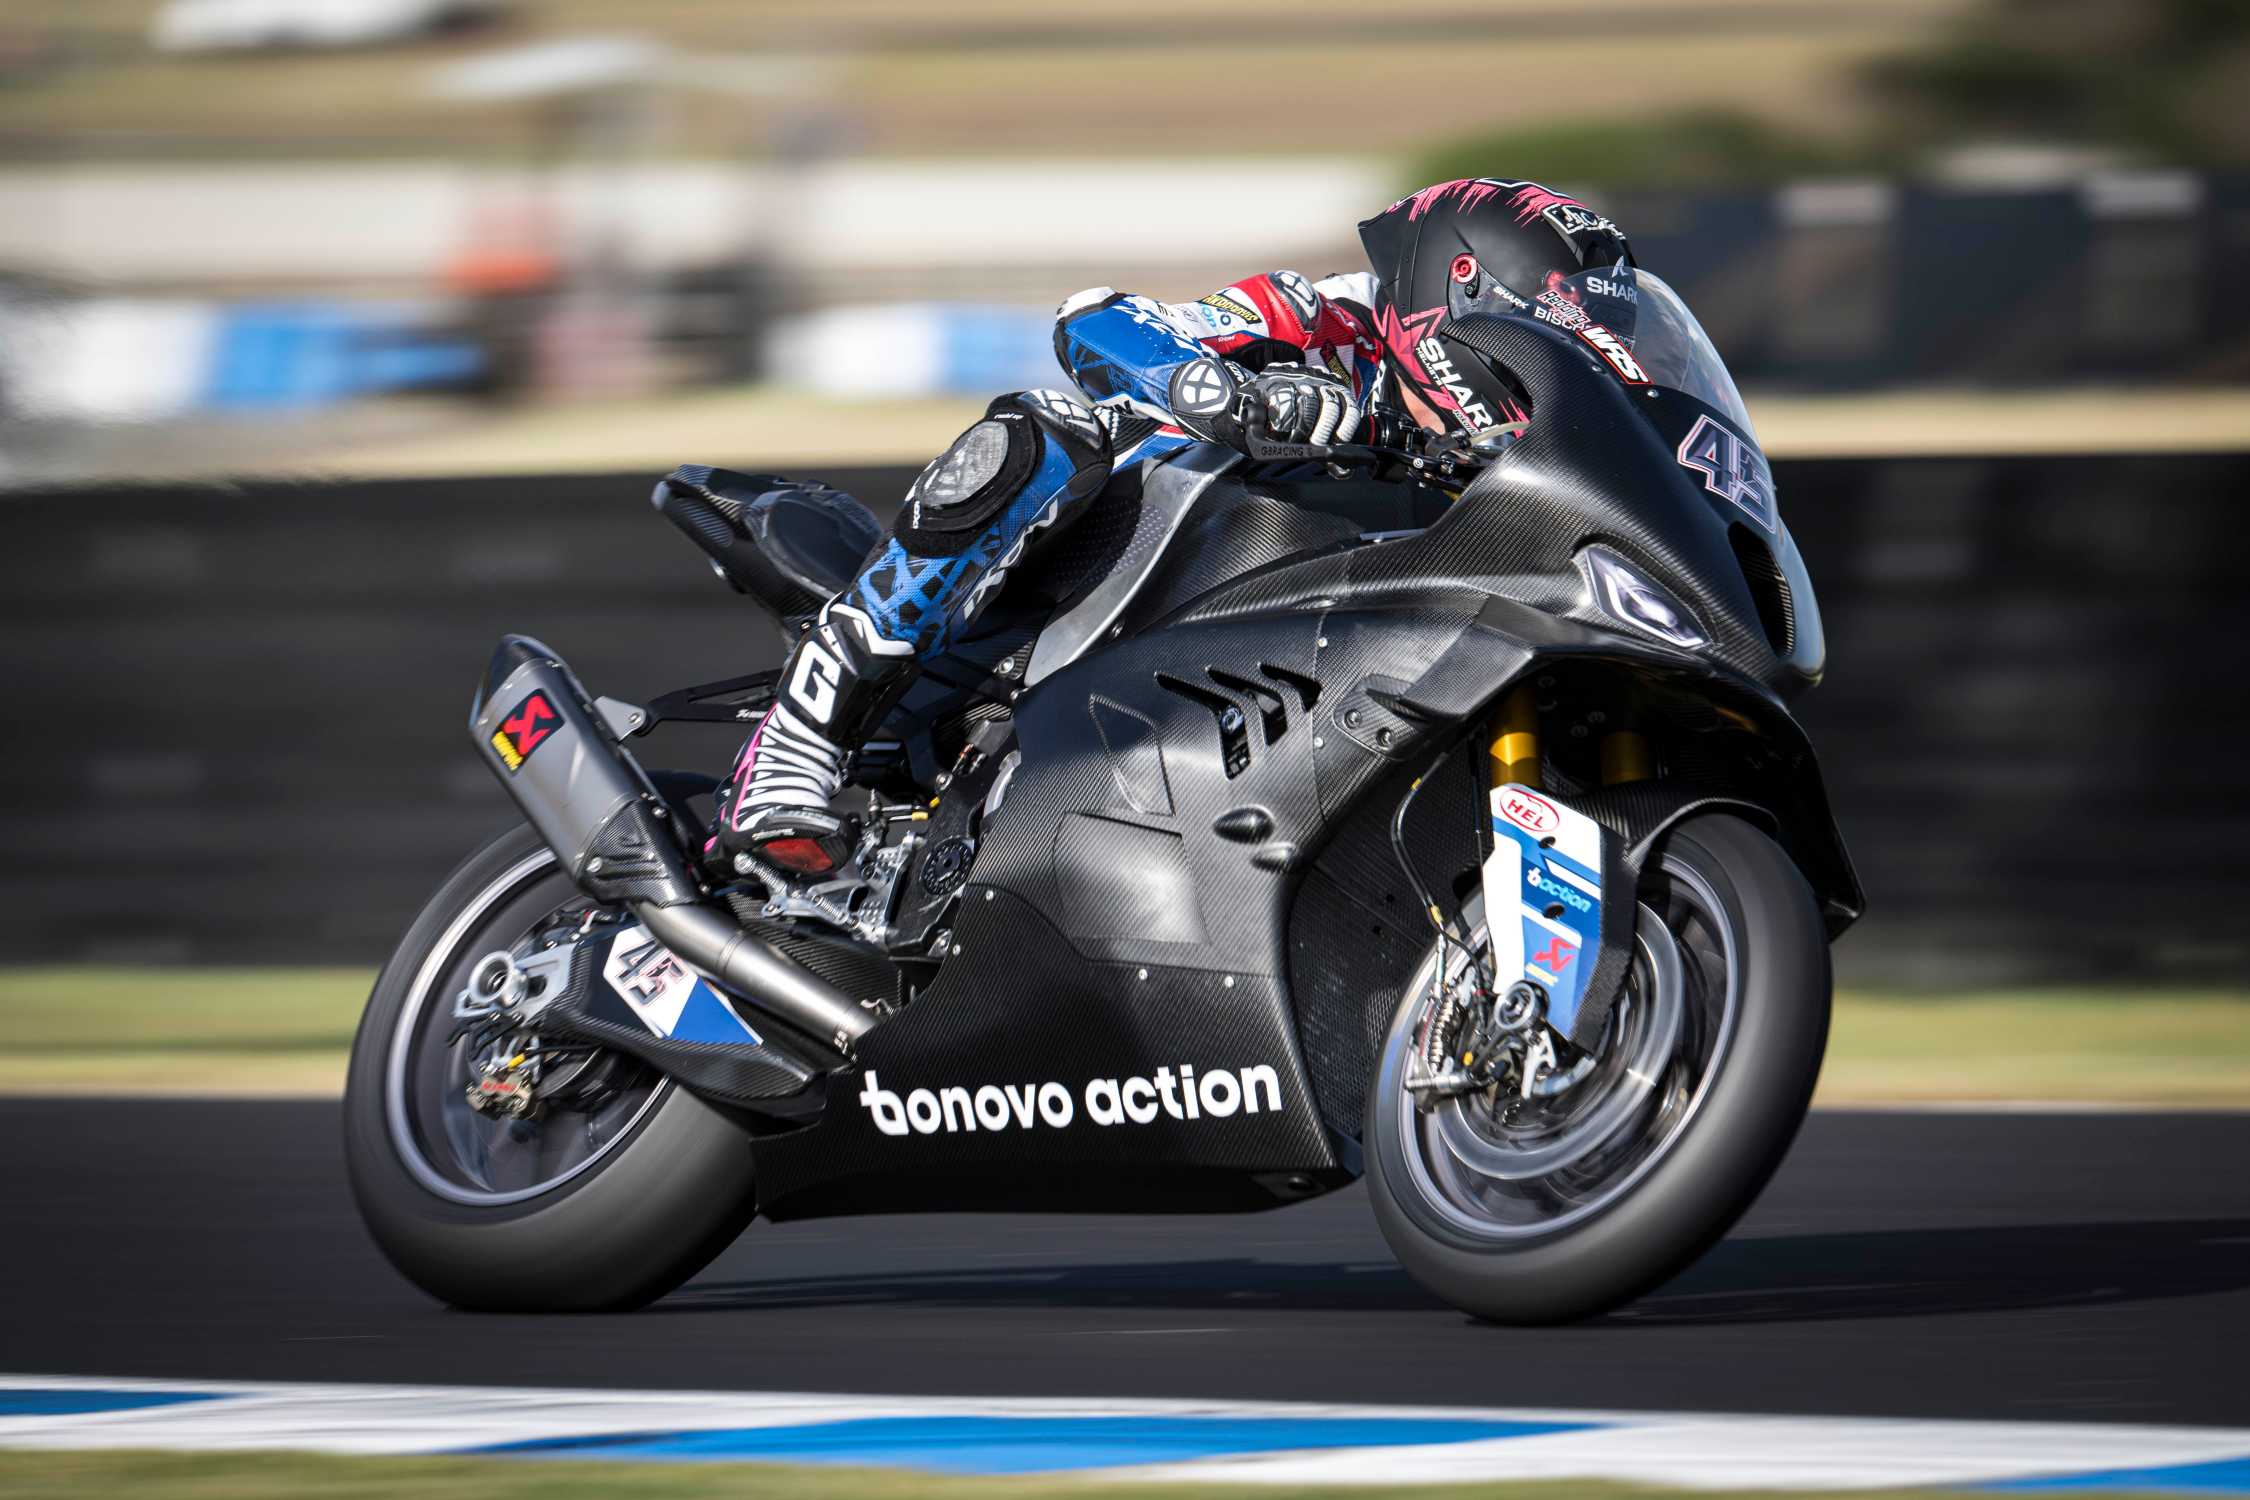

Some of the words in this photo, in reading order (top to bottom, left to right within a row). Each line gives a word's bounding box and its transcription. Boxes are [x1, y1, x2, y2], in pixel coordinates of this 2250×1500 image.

[1492, 285, 1530, 310] SHARK
[1586, 275, 1638, 305] SHARK
[1580, 325, 1650, 383] WRS
[1420, 337, 1500, 434] SHAR
[1507, 799, 1544, 829] HEL
[859, 1070, 1074, 1136] bonovo
[1085, 1064, 1283, 1126] action
